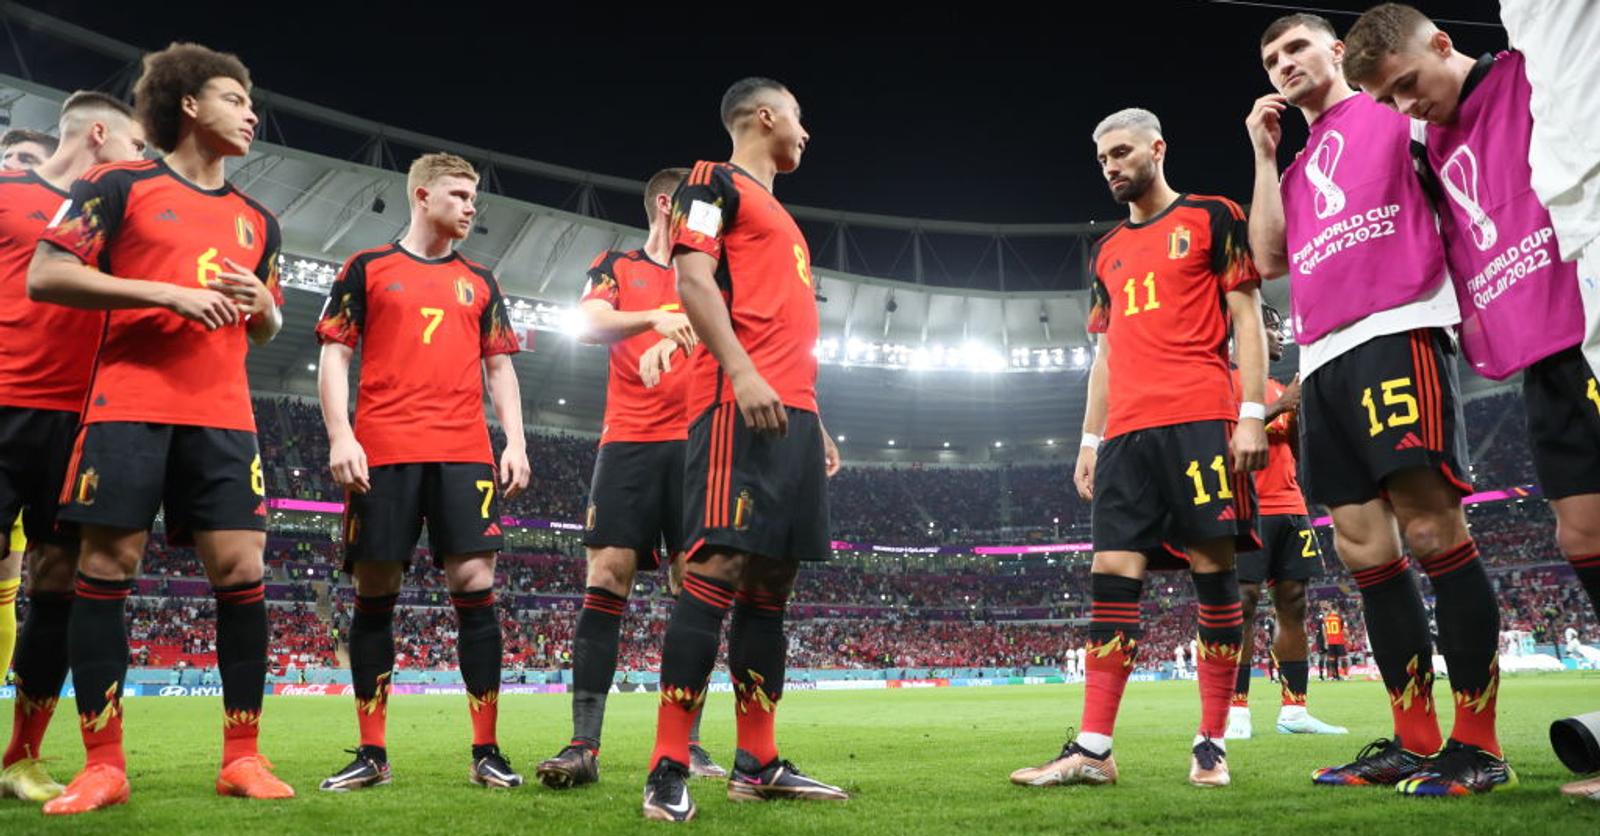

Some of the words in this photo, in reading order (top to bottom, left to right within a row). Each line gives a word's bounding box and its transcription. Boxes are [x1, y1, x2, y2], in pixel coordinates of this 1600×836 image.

[1292, 242, 1314, 264] FIFA
[1312, 214, 1365, 248] WORLD
[1365, 204, 1400, 222] CUP
[197, 247, 224, 288] 6
[1466, 272, 1487, 295] FIFA
[1484, 246, 1520, 281] WORLD
[1520, 227, 1553, 254] CUP
[1123, 271, 1161, 317] 11
[420, 307, 445, 344] 7
[1361, 377, 1420, 437] 15
[476, 480, 494, 519] 7
[1186, 455, 1234, 506] 11
[1298, 529, 1317, 558] 2
[1325, 620, 1339, 635] 10
[190, 685, 224, 697] HYU
